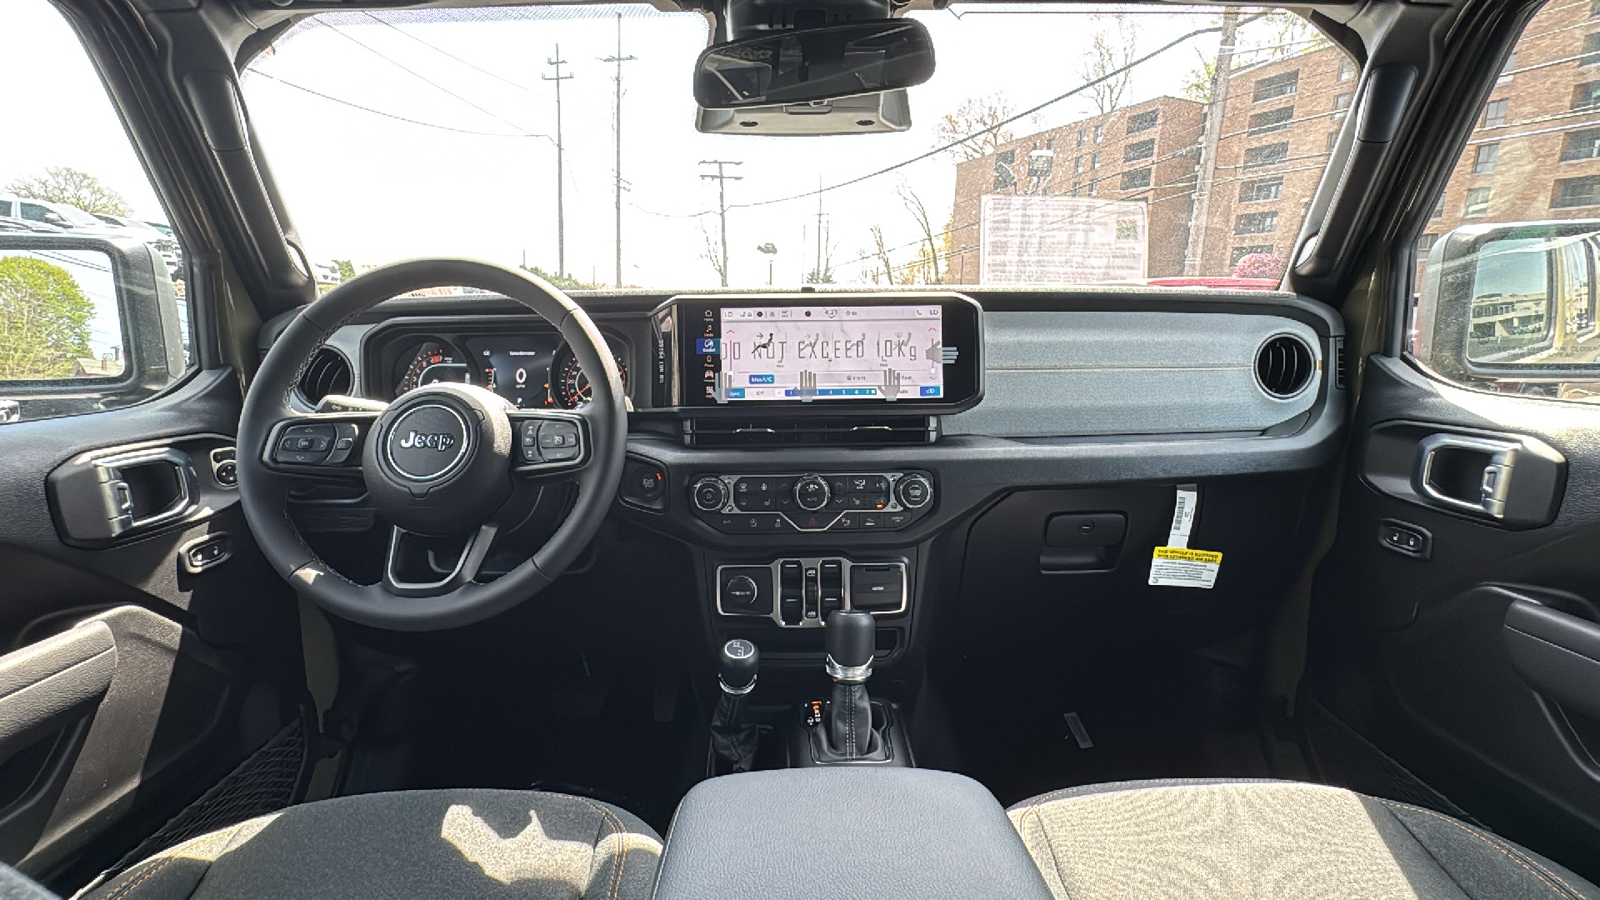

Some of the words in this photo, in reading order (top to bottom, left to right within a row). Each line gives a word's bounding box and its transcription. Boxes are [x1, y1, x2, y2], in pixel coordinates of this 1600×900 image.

[720, 341, 741, 360] DO
[798, 339, 864, 359] EXCEED
[515, 368, 527, 384] 0
[400, 430, 455, 451] Jeep
